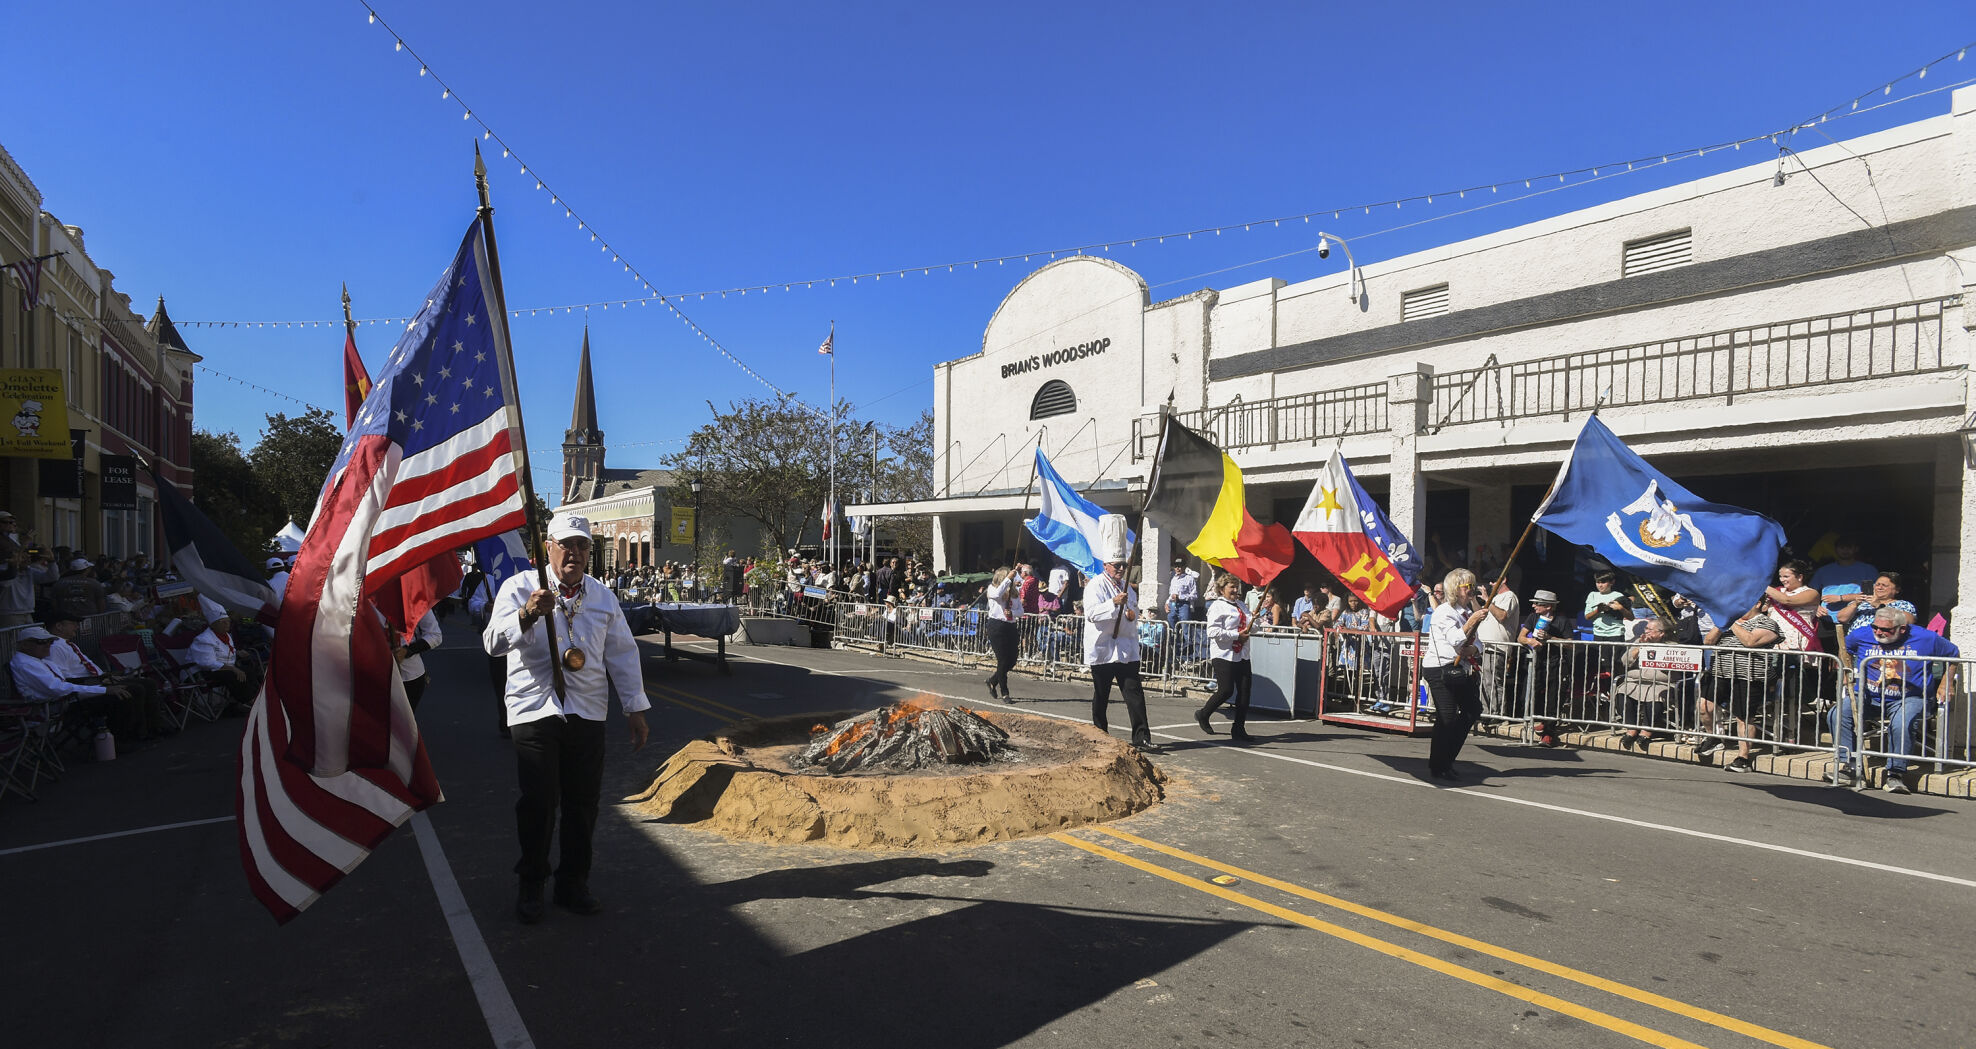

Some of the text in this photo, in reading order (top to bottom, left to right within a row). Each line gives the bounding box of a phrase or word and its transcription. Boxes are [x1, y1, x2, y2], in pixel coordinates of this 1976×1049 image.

[1001, 337, 1111, 379] BRIAN'S WOODSHOP
[9, 375, 44, 383] GIANT
[0, 381, 59, 393] Omelette
[2, 392, 54, 401] Celebration
[108, 467, 129, 475] FOR
[104, 476, 134, 484] LEASE
